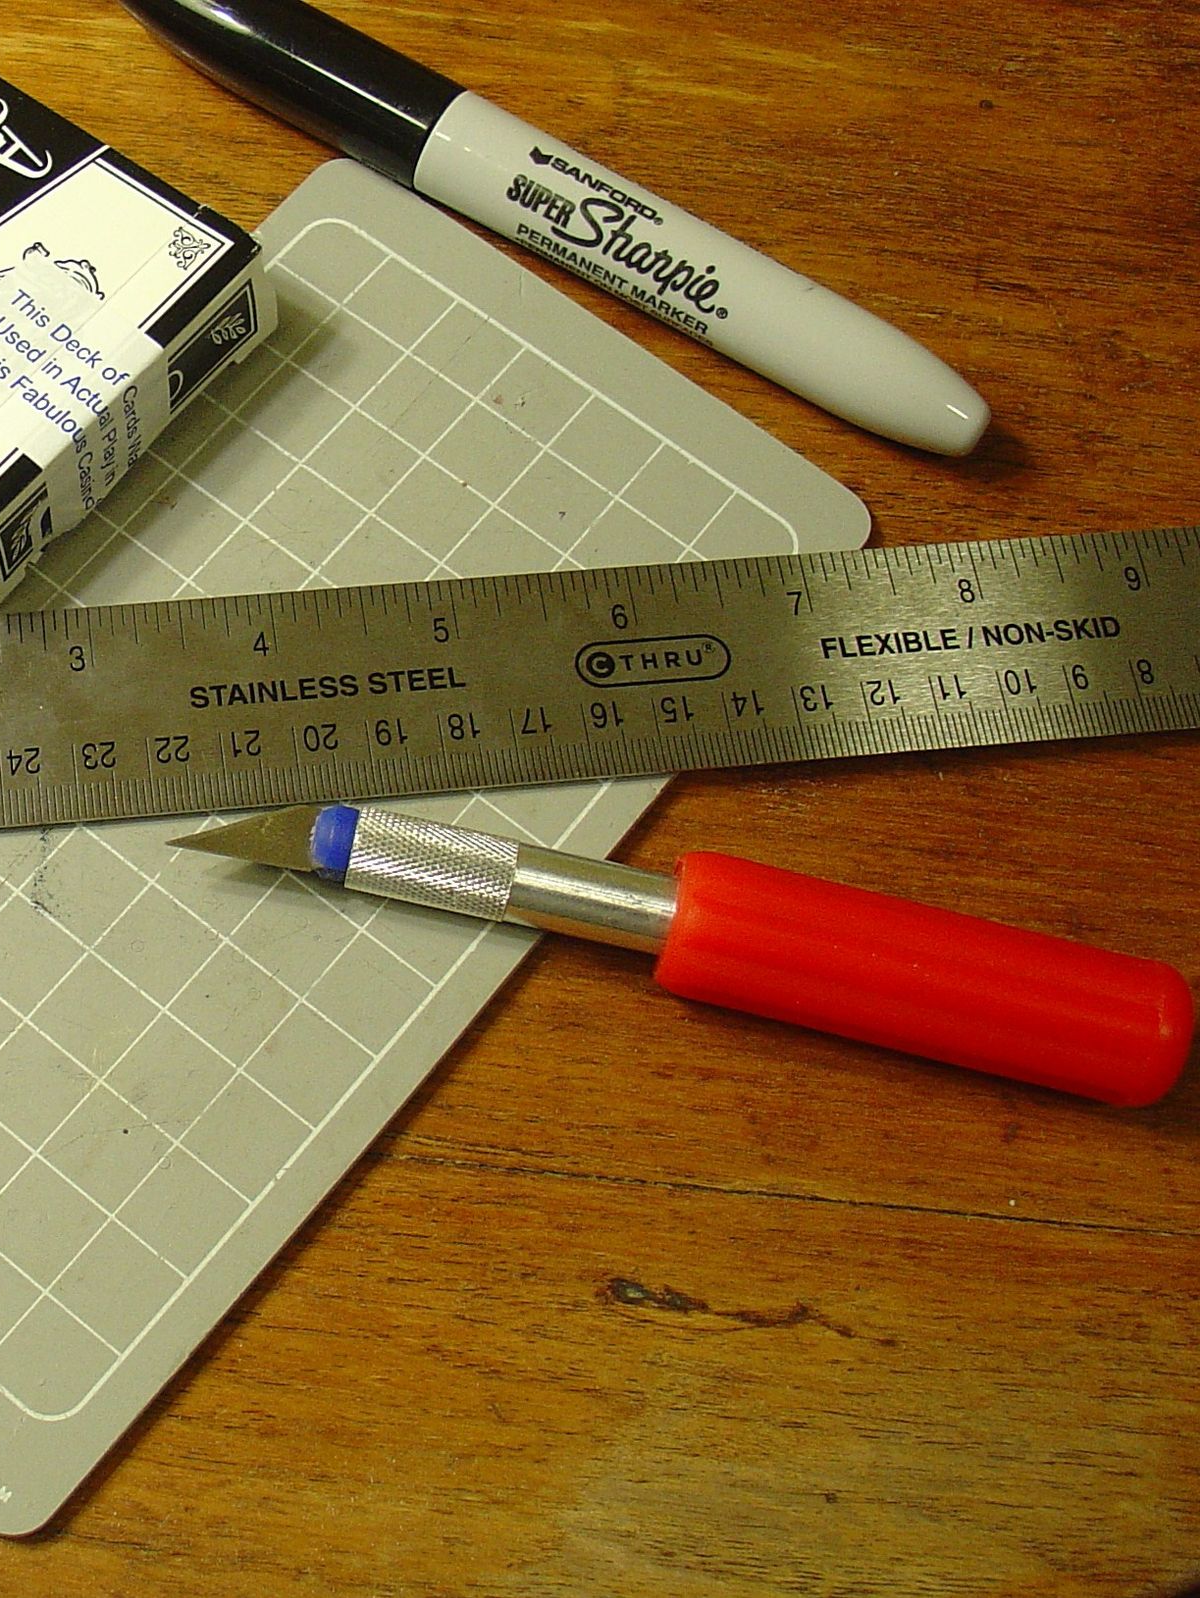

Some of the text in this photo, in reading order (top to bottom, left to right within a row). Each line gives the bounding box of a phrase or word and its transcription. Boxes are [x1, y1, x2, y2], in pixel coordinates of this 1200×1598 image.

[551, 157, 658, 221] SANFORD
[506, 174, 720, 314] SUPER Sharpie
[516, 223, 709, 335] PERMANENT MARKER
[10, 289, 144, 468] This Deck of Cards Wa
[41, 358, 63, 380] in
[60, 376, 114, 431] Actual
[102, 427, 117, 471] Play
[10, 375, 87, 453] Fabulous
[77, 451, 96, 511] Casino
[69, 645, 86, 672] 3
[253, 631, 270, 657] 4
[433, 617, 450, 644] 5
[611, 604, 628, 629] 6
[786, 591, 802, 616] 7
[957, 578, 975, 604] 8
[1123, 565, 1142, 591] 9
[820, 629, 958, 660] FLEXIBLE
[983, 616, 1122, 648] NON-SKID
[1004, 668, 1038, 696] 10
[1072, 664, 1089, 690] 9
[1138, 658, 1155, 685] 8
[190, 666, 467, 709] STAINLESS STEEL
[800, 684, 834, 711] 13
[866, 679, 901, 706] 12
[936, 674, 967, 702] 11
[591, 701, 624, 728] 16
[661, 696, 694, 723] 15
[731, 690, 764, 717] 14
[375, 717, 408, 745] 19
[450, 712, 481, 740] 18
[521, 706, 552, 735] 17
[155, 735, 190, 764] 22
[231, 729, 262, 757] 21
[303, 723, 339, 752] 20
[6, 747, 42, 776] 24
[82, 741, 117, 770] 23
